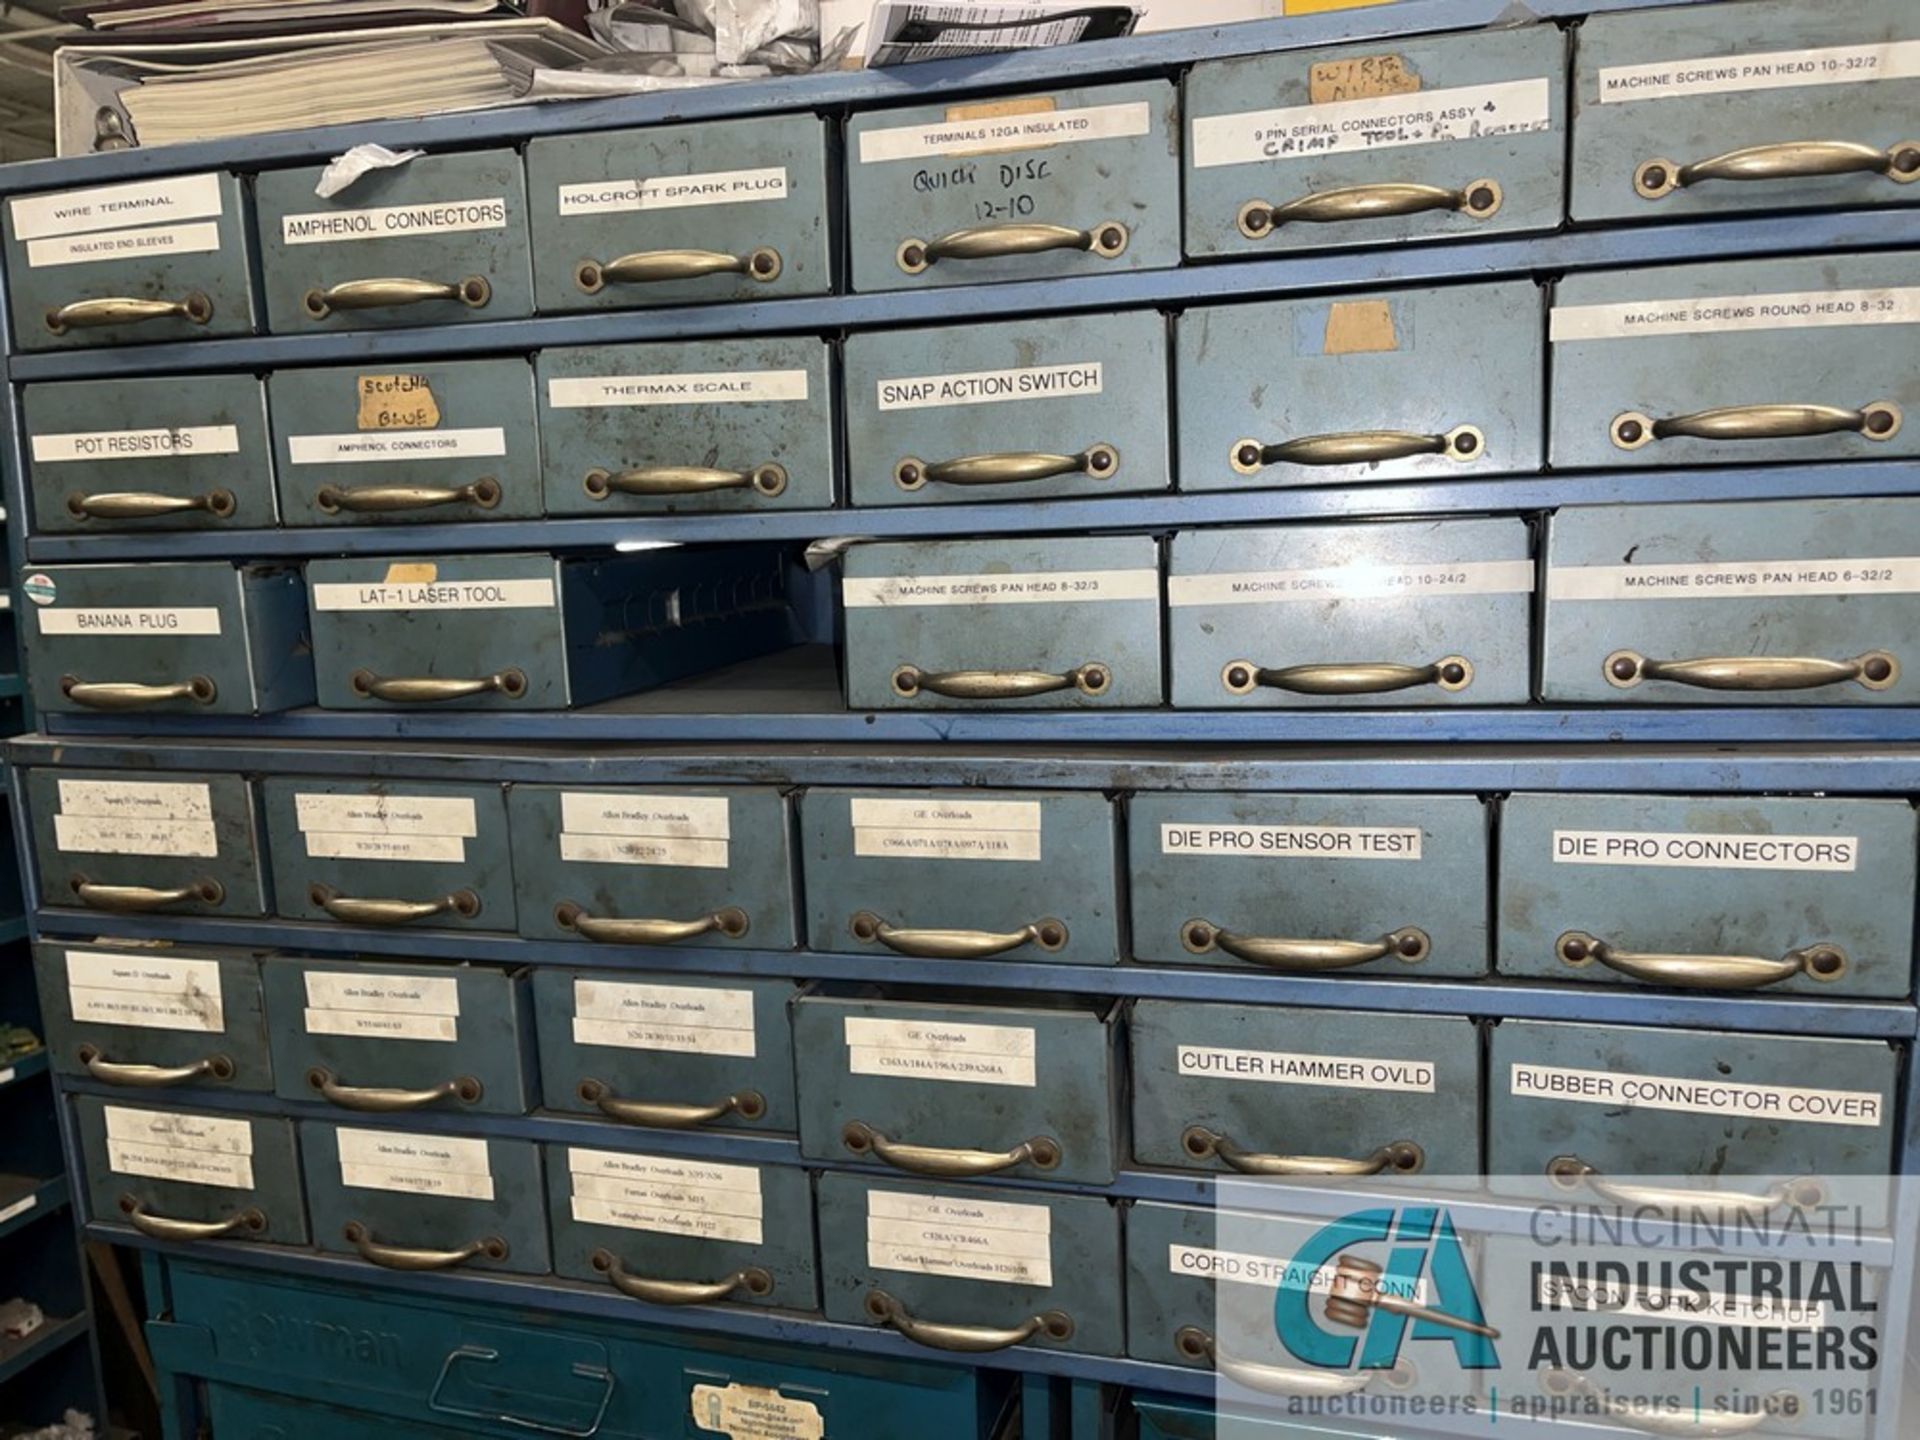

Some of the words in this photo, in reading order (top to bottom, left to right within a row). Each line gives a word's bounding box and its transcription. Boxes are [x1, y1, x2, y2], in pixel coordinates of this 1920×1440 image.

[1607, 74, 1670, 90] MACHINE
[1675, 67, 1737, 83] SCREWS
[1742, 65, 1771, 78] PAN
[1776, 61, 1815, 75] HEAD
[1820, 56, 1877, 72] 10-32/2
[923, 129, 986, 145] TERMINALS
[990, 126, 1021, 139] 12GA
[1023, 118, 1089, 135] INSULATED
[1254, 130, 1263, 141] 9
[1266, 128, 1287, 140] PIN
[1291, 123, 1336, 137] SERIAL
[1341, 110, 1434, 132] CONNECTORS
[1439, 106, 1477, 121] ASSY
[999, 158, 1052, 188] DISC
[563, 188, 661, 205] HOLCROFT
[665, 183, 727, 197] SPARK
[732, 177, 783, 191] PLUG
[53, 206, 92, 219] WIRE
[100, 196, 175, 213] TERMINAL
[974, 194, 1035, 220] 12-10
[287, 215, 377, 237] AMPHENOL
[385, 204, 504, 230] CONNECTORS
[70, 239, 115, 254] INSULATED
[117, 237, 135, 249] END
[136, 235, 174, 247] SLEEVES
[1624, 311, 1688, 325] MACHINE
[1693, 306, 1755, 321] SCREWS
[1760, 303, 1811, 317] ROUND
[1816, 300, 1855, 313] HEAD
[1860, 300, 1894, 312] 8-32
[601, 383, 688, 396] THERMAX
[693, 381, 752, 394] SCALE
[883, 383, 935, 403] SNAP
[940, 376, 1013, 399] ACTION
[1018, 369, 1098, 393] SWITCH
[75, 438, 102, 454] POT
[108, 433, 193, 452] RESISTORS
[337, 441, 388, 453] AMPHENOL
[391, 439, 458, 451] CONNECTORS
[899, 584, 948, 596] MACHINE
[951, 582, 998, 594] SCREWS
[1000, 582, 1024, 593] PAN
[1027, 581, 1057, 593] HEAD
[1231, 580, 1287, 593] MACHINE
[1418, 572, 1467, 586] 10-24/2
[1625, 574, 1690, 587] MACHINE
[1695, 571, 1758, 585] SCREWS
[1762, 571, 1793, 584] PAN
[1798, 570, 1838, 582] HEAD
[1842, 569, 1893, 582] 6-32/2
[359, 588, 404, 604] LAT-1
[408, 587, 460, 604] LASER
[465, 586, 507, 602] TOOL
[77, 612, 132, 629] BANANA
[139, 612, 178, 629] PLUG
[931, 810, 973, 820] Overloads
[1168, 830, 1202, 847] DIE
[1208, 830, 1254, 849] PRO
[1260, 831, 1352, 851] SENSOR
[1358, 834, 1416, 852] TEST
[1558, 836, 1598, 855] DIE
[1606, 838, 1659, 859] PRO
[1666, 839, 1851, 863] CONNECTORS
[925, 1032, 967, 1043] Overloads
[1181, 1051, 1264, 1074] CUTLER
[1270, 1059, 1364, 1082] HAMMER
[1370, 1065, 1432, 1086] OVLD
[1516, 1071, 1614, 1096] RUBBER
[1621, 1080, 1781, 1112] CONNECTOR
[1787, 1095, 1878, 1118] COVER
[945, 1207, 985, 1218] Overloads
[1180, 1252, 1241, 1275] CORD
[1246, 1259, 1351, 1291] STRAIGHT
[1357, 1276, 1423, 1301] CONN
[1543, 1281, 1625, 1306] SPOON
[1706, 1298, 1821, 1324] KETCHUP
